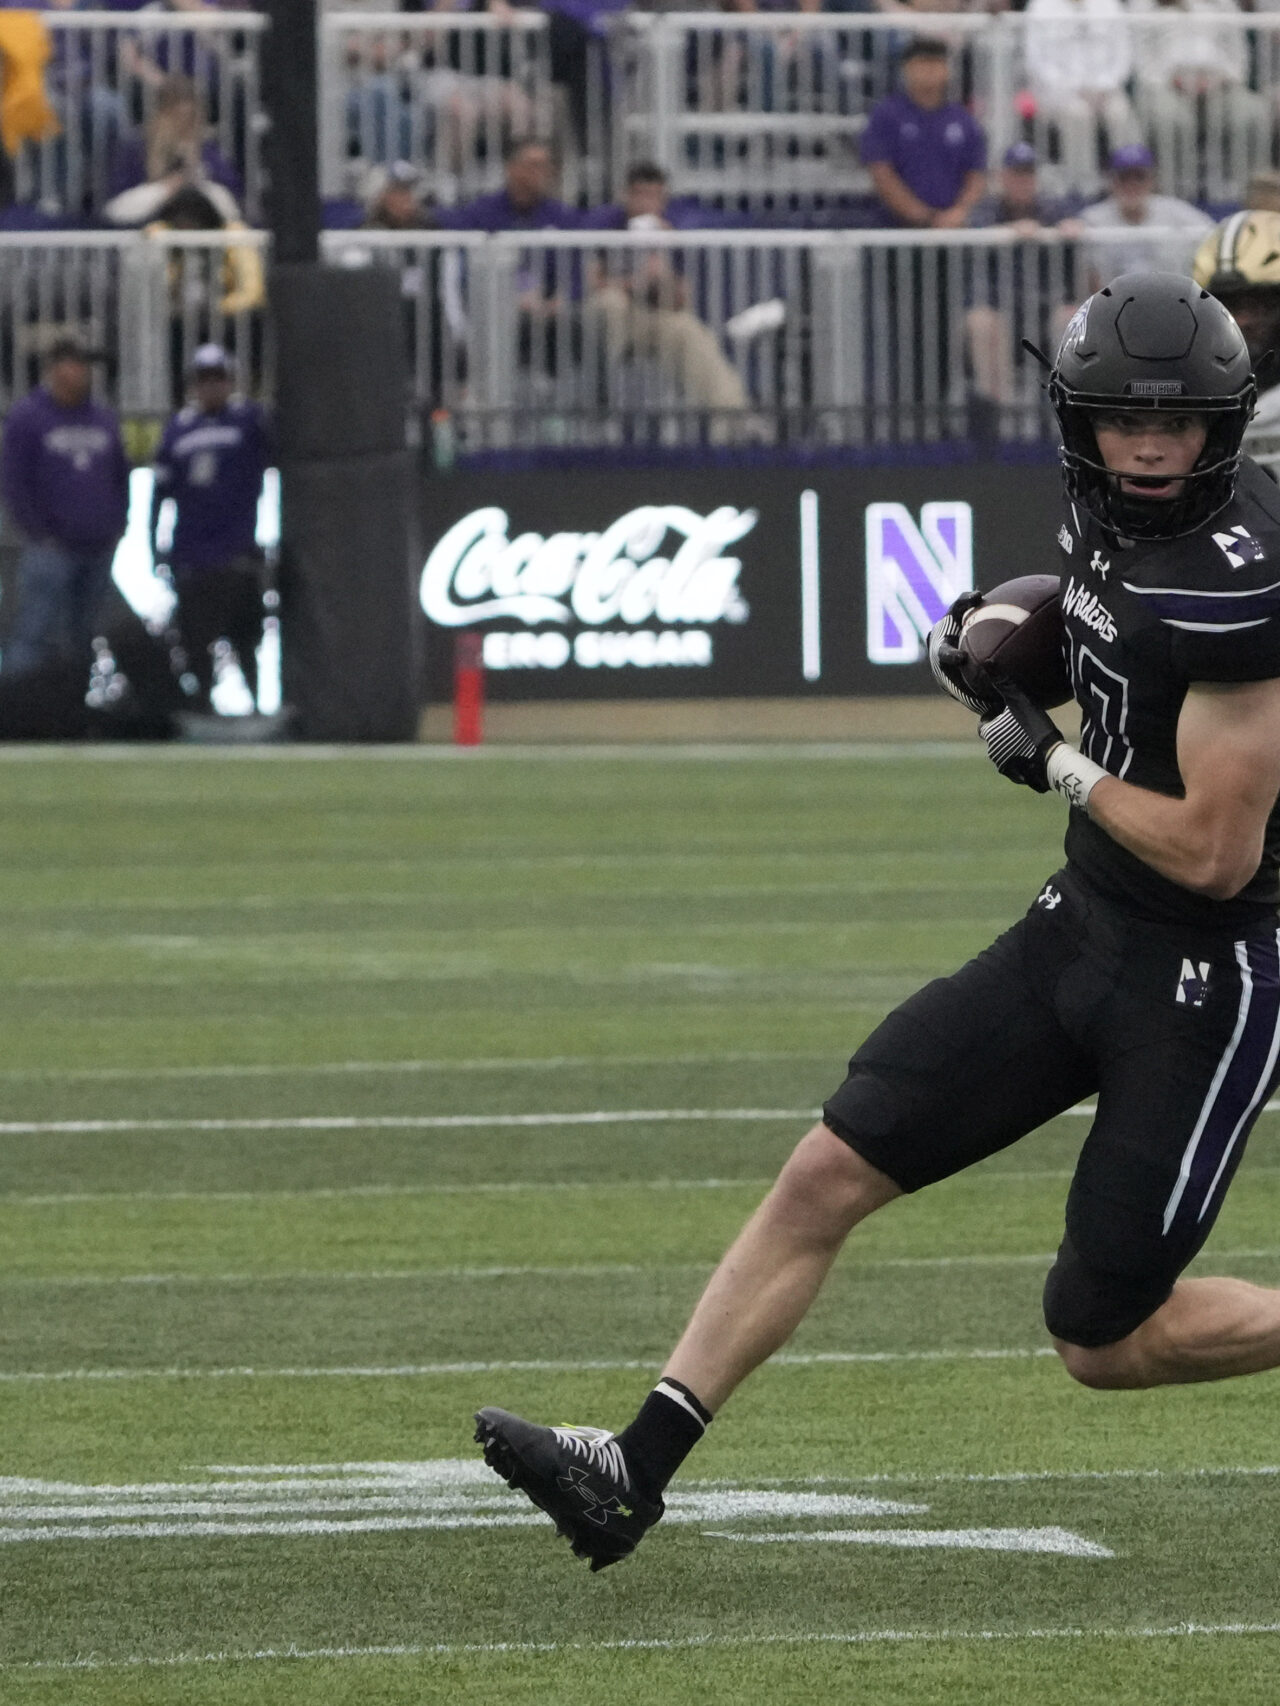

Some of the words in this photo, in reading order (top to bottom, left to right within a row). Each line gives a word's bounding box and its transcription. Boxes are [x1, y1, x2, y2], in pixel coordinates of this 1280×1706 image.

[1131, 382, 1182, 395] WILDCATS
[419, 506, 759, 627] Coca-Cola
[866, 502, 974, 664] N
[1062, 575, 1118, 643] Wildcats
